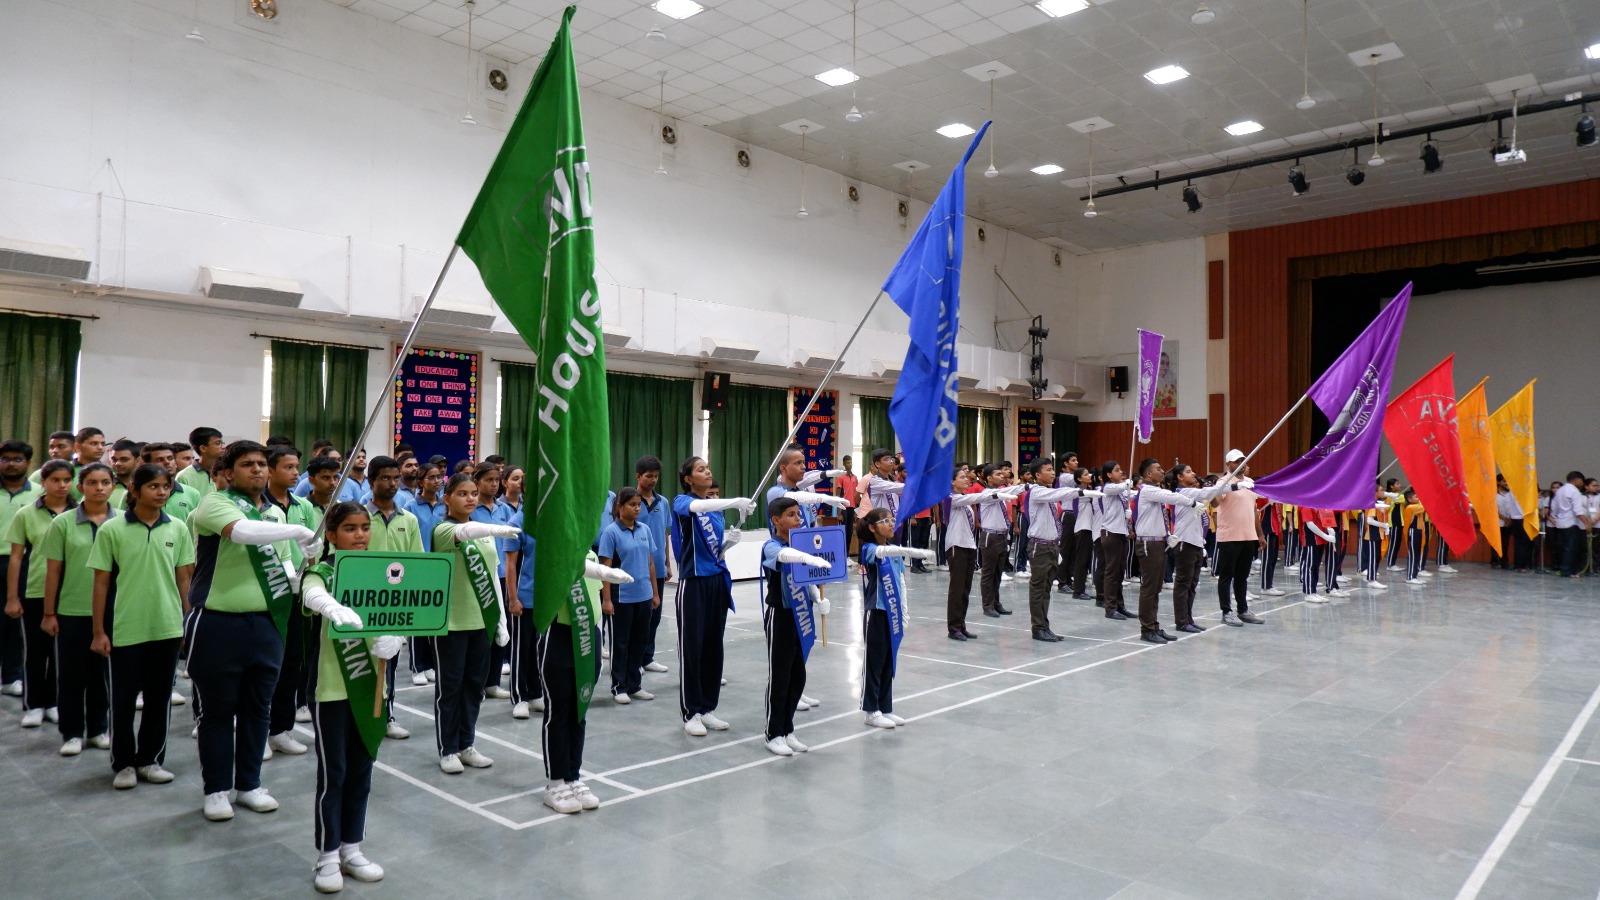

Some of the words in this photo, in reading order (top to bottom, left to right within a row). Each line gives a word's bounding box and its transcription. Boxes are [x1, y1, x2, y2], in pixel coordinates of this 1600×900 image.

[539, 289, 602, 432] HOUS
[415, 366, 458, 376] EDUCATION
[420, 380, 437, 388] ONE
[443, 382, 466, 390] THING
[408, 394, 420, 402] NO
[426, 395, 442, 403] ONE
[414, 409, 431, 417] TAKE
[439, 410, 461, 418] AWAY
[413, 424, 434, 432] FROM
[441, 425, 458, 433] YOU
[256, 543, 290, 600] PTAIN
[465, 544, 495, 609] CAPTAIN
[808, 567, 831, 578] HOUSE
[570, 580, 585, 604] ICE
[882, 573, 895, 597] VICE
[340, 590, 444, 607] AUROBINDO
[367, 612, 414, 629] HOUSE
[888, 597, 900, 635] CAPTAIN
[575, 606, 592, 657] CAPTAIN
